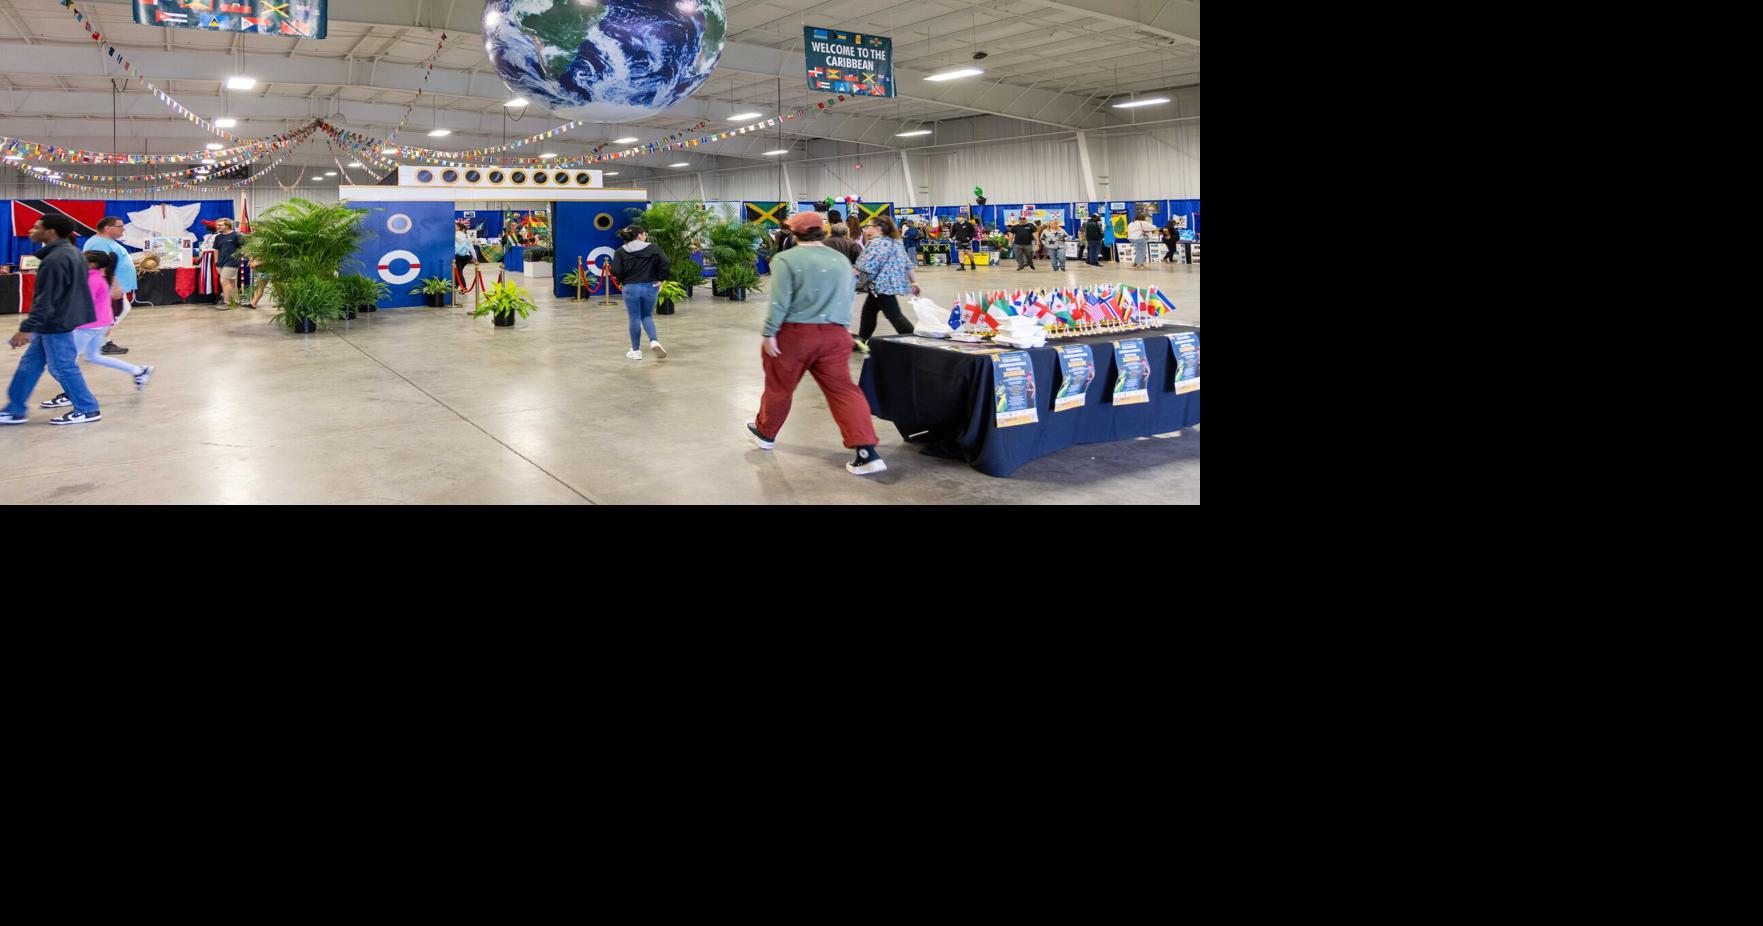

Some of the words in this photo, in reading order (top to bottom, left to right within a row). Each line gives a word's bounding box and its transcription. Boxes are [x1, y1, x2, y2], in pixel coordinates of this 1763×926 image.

[811, 41, 855, 56] WELCOME
[857, 47, 869, 58] TO
[871, 49, 886, 61] THE
[826, 56, 874, 71] CARIBBEAN
